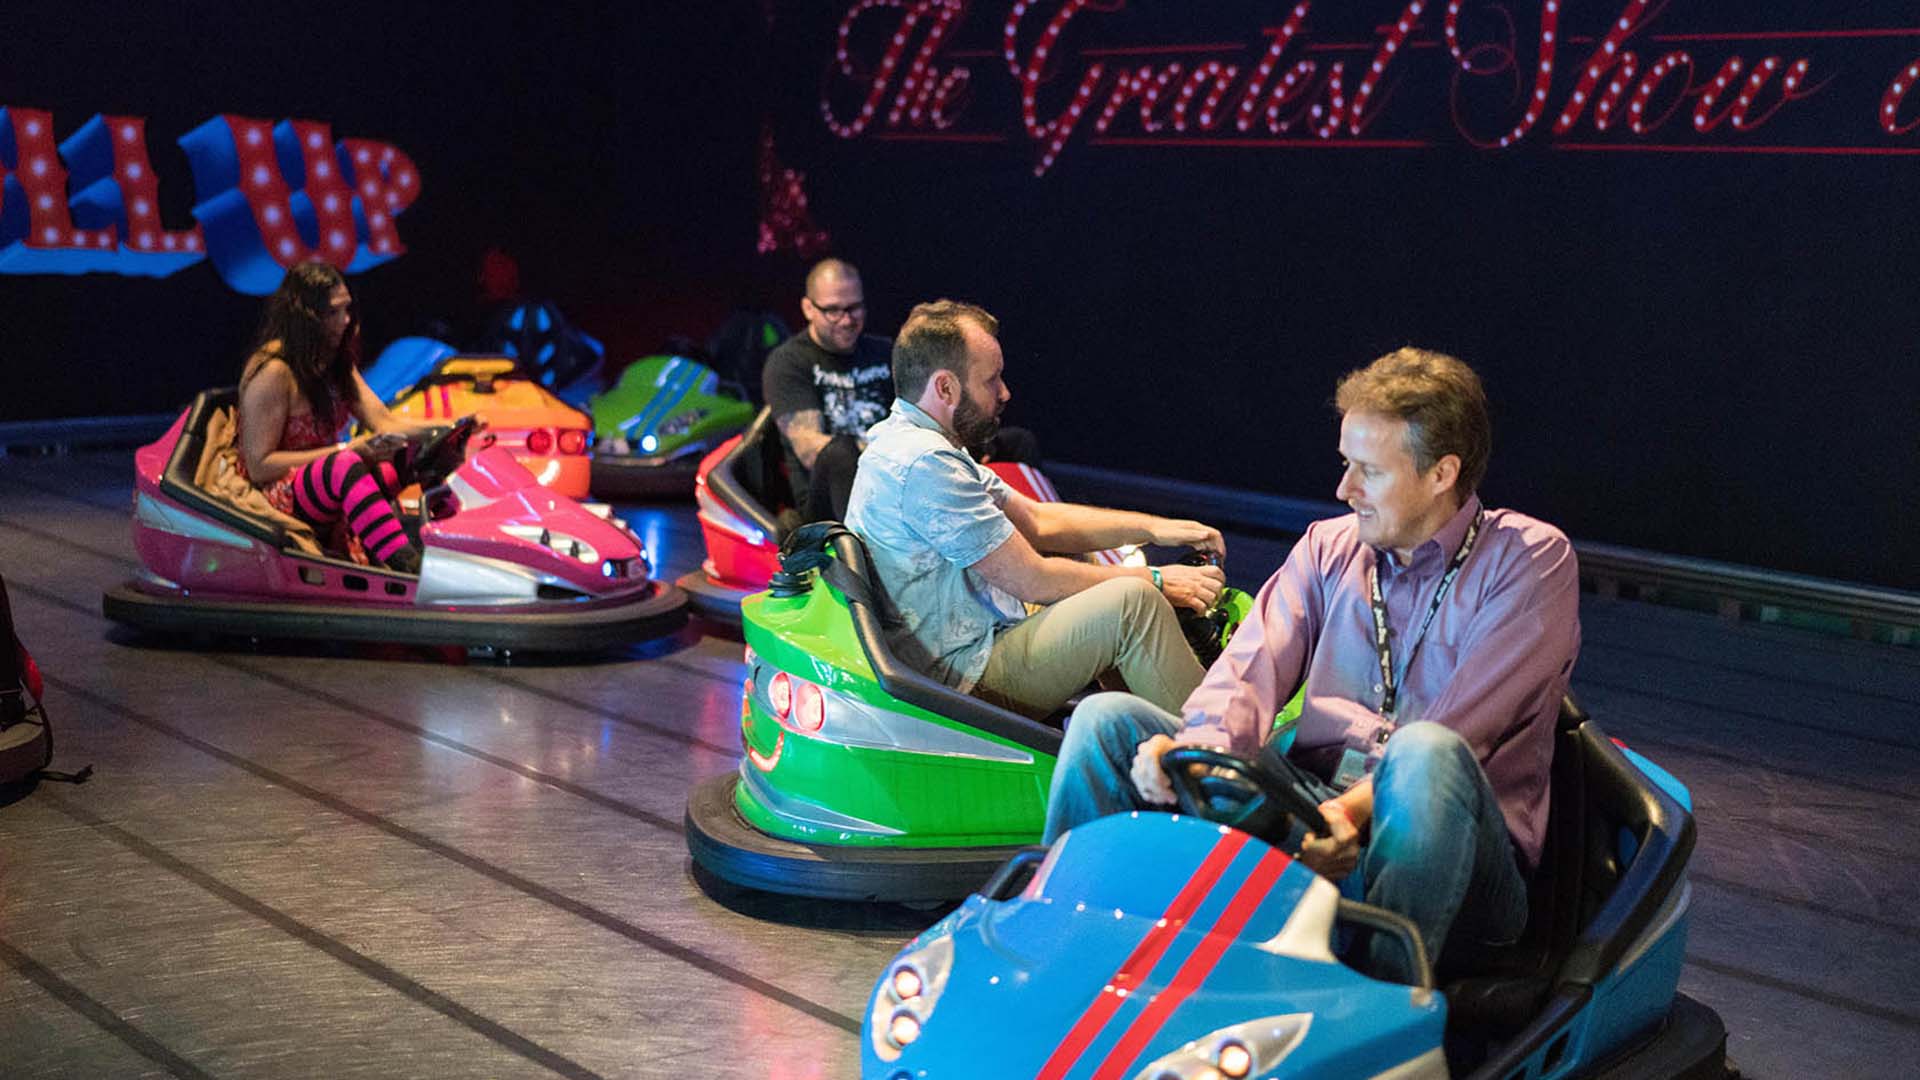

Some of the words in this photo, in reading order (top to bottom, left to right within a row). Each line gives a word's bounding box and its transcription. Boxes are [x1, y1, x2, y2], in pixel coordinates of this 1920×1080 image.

[1005, 0, 1424, 176] Greatest
[1447, 0, 1830, 148] Show
[0, 107, 205, 268] LL
[186, 113, 421, 285] UP
